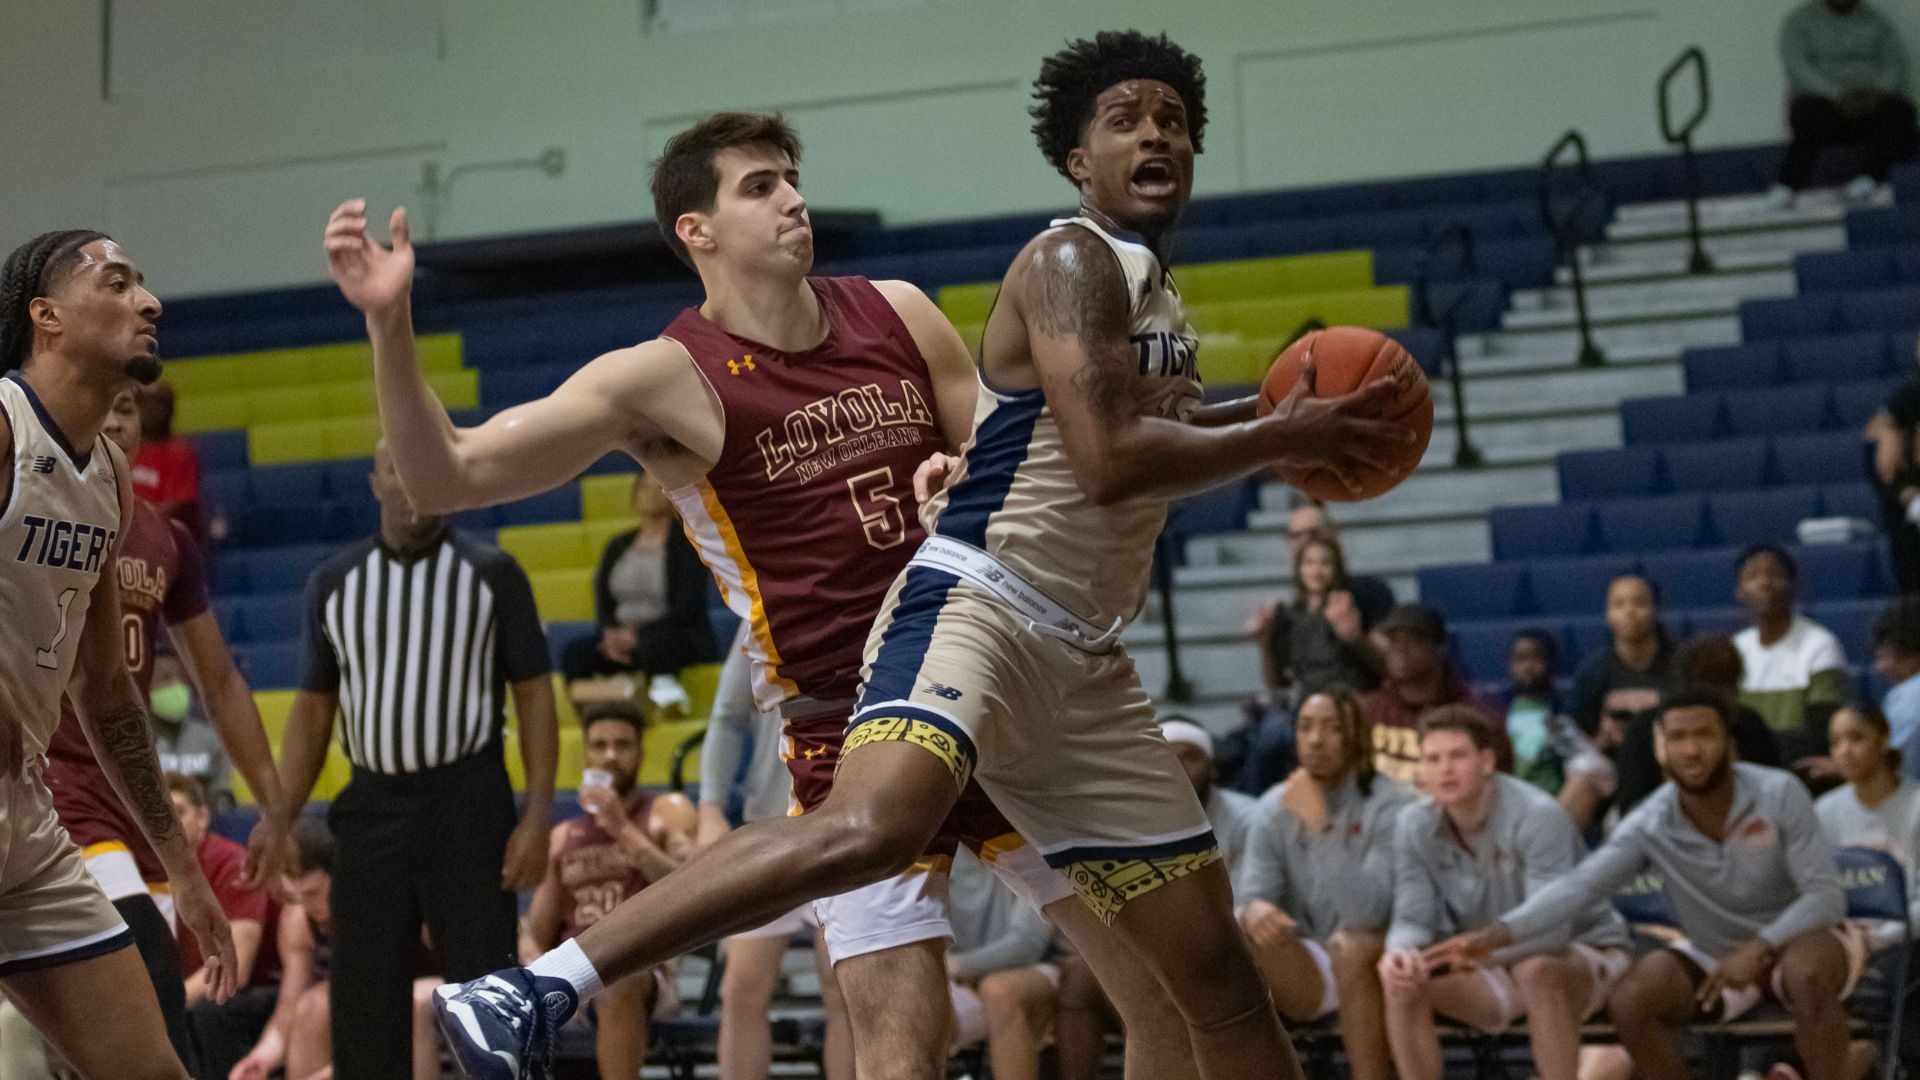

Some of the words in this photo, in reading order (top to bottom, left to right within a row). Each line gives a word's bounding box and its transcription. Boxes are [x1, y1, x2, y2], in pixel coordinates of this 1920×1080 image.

[755, 379, 934, 482] LOYOLA
[795, 450, 837, 486] NEW
[838, 426, 922, 462] ORLEANS
[846, 465, 906, 550] 5
[36, 587, 79, 671] 1
[1002, 579, 1020, 595] new
[1019, 589, 1047, 615] balance
